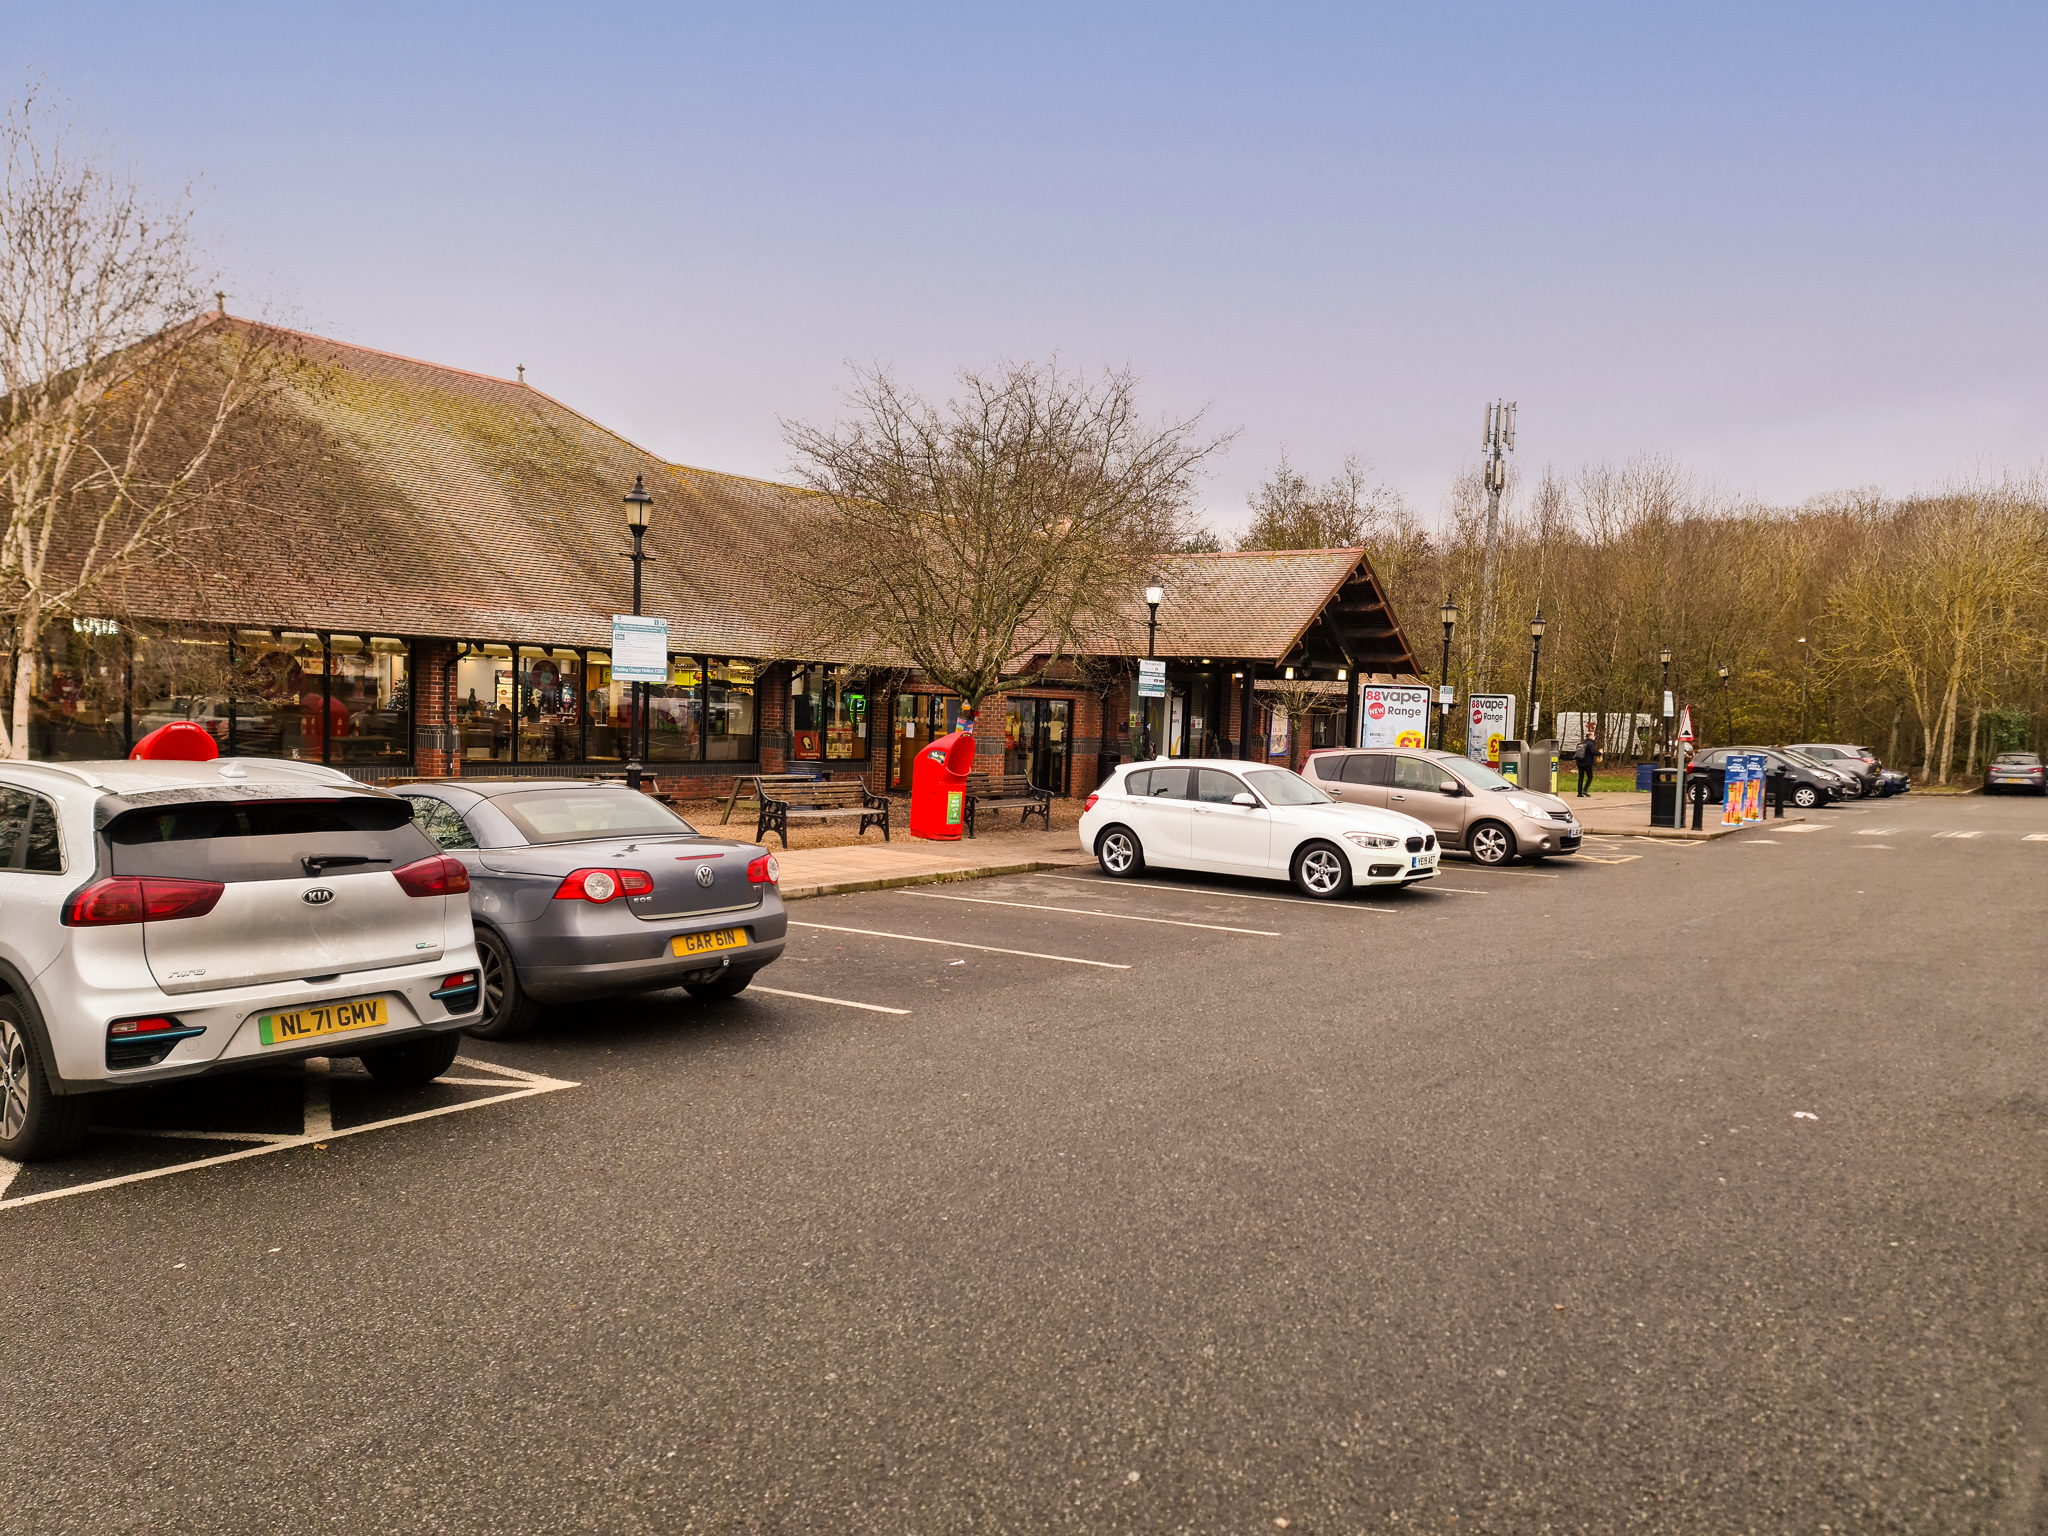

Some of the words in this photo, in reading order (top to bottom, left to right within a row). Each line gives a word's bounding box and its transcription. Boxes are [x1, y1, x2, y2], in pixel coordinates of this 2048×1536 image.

[1368, 707, 1385, 715] NEW
[1387, 706, 1421, 718] Range
[1483, 712, 1503, 722] Range
[308, 890, 331, 902] KIA
[686, 936, 712, 951] GAR
[280, 1010, 332, 1037] NL71
[337, 1002, 377, 1027] GMV
